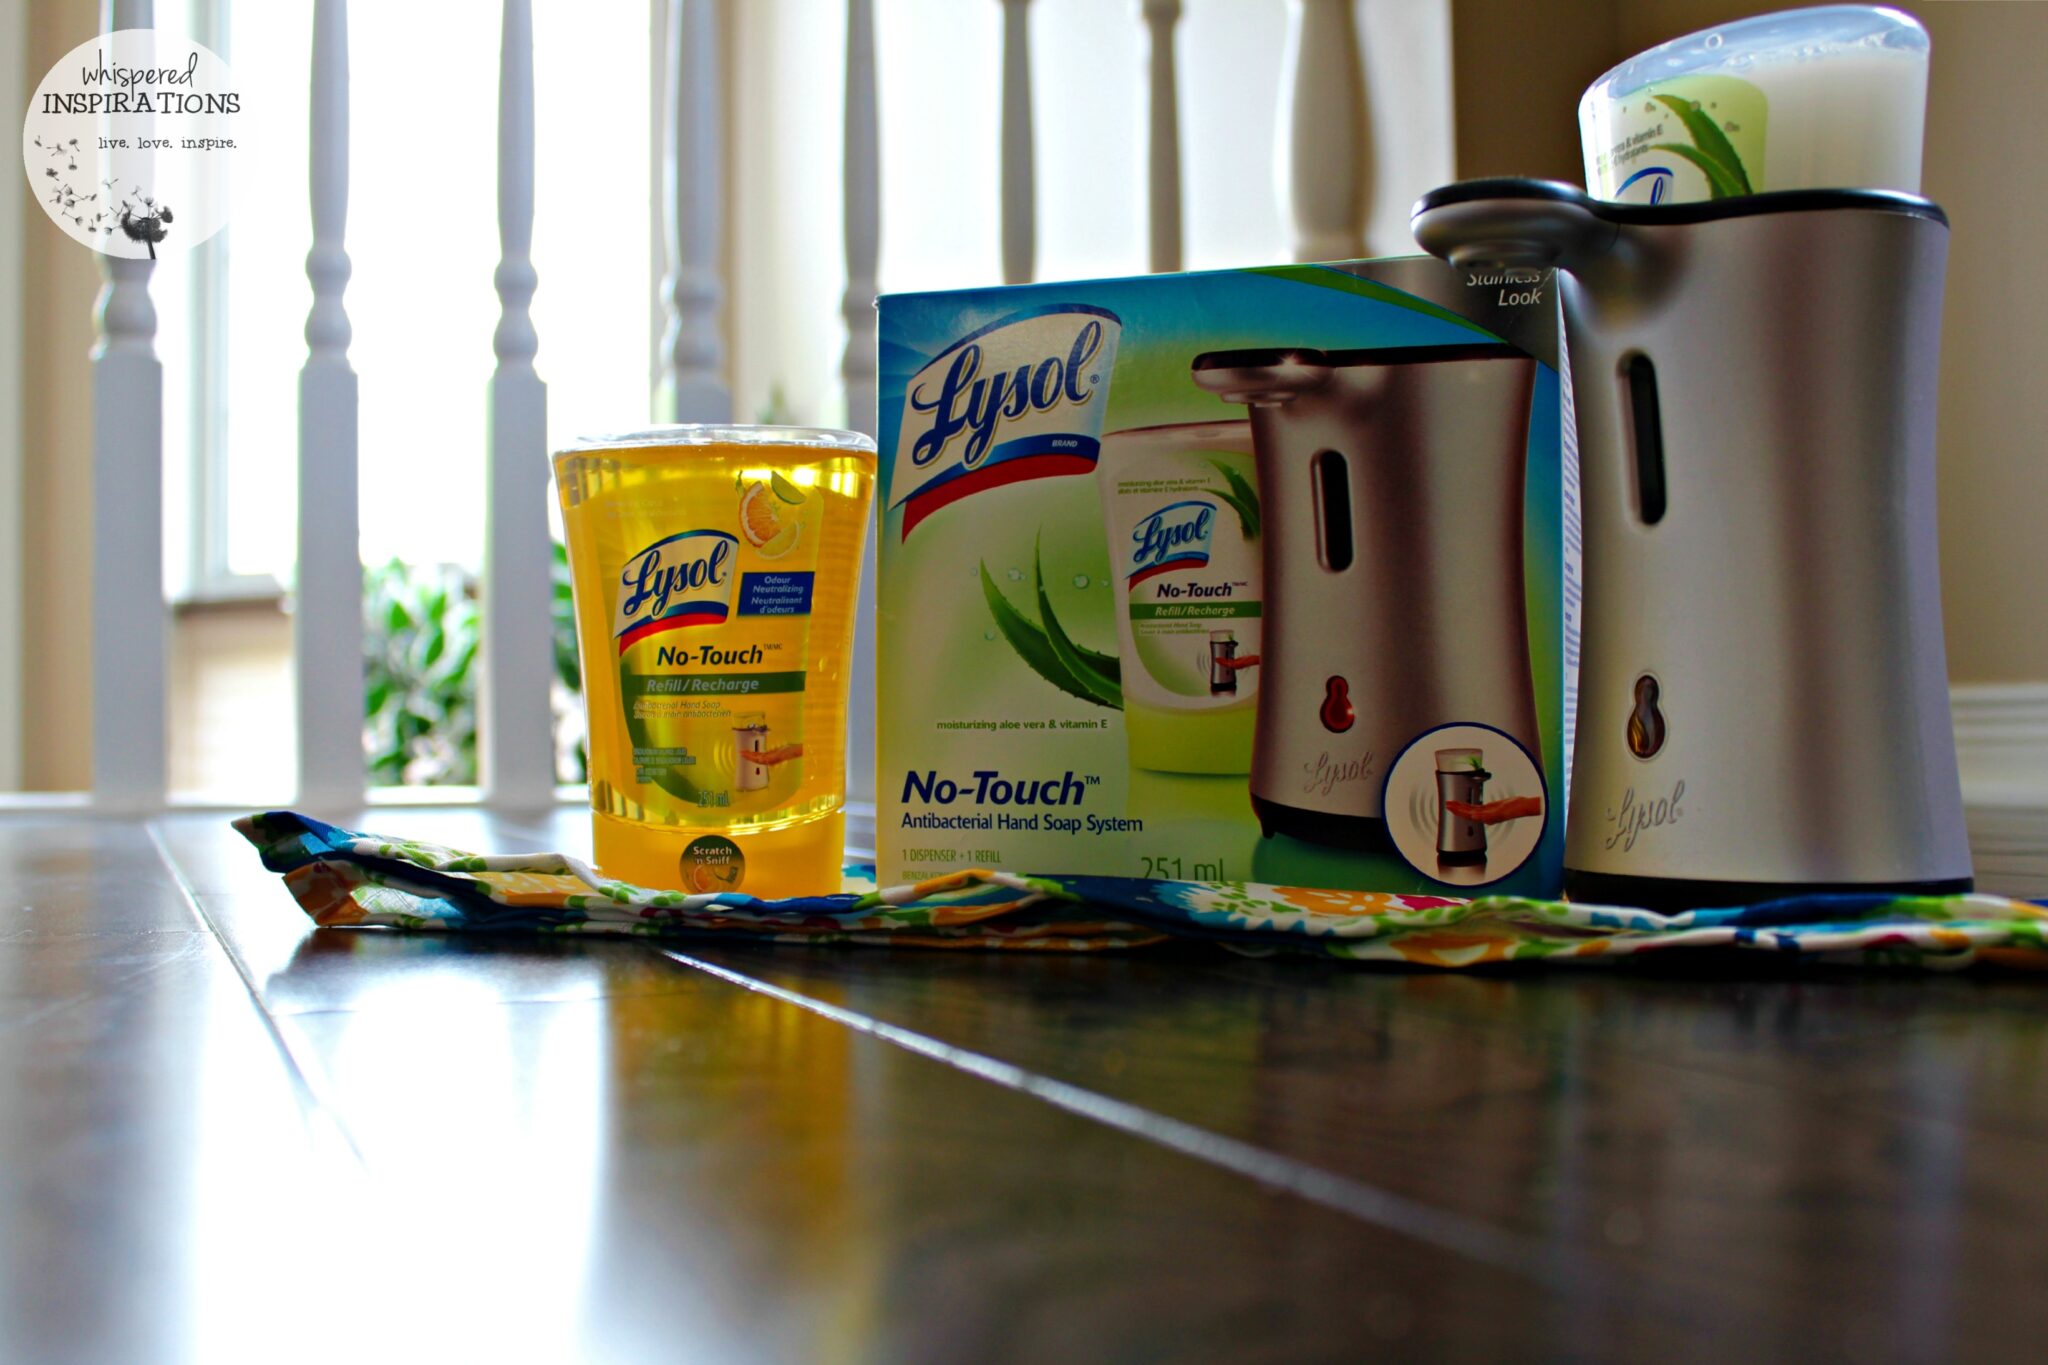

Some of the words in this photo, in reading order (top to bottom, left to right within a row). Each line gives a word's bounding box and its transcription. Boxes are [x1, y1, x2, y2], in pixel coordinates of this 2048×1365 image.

[1498, 287, 1543, 306] Look
[911, 320, 1102, 466] Lysol
[1052, 439, 1078, 448] BRAND
[1132, 507, 1210, 563] Lysol
[622, 539, 729, 617] Lysol
[764, 575, 791, 584] Odour
[753, 584, 804, 594] Neutralizing
[1156, 582, 1232, 598] No-Touch
[751, 596, 803, 605] Neutralisant
[657, 644, 763, 667] No-Touch
[937, 719, 997, 732] moisturizing
[1000, 719, 1021, 730] aloe
[1024, 721, 1046, 730] vera
[1048, 719, 1057, 729] &
[1060, 718, 1098, 729] vitamin
[1101, 719, 1108, 729] E
[1303, 751, 1374, 796] Lysol
[901, 770, 1085, 806] No-Touch
[901, 812, 993, 830] Antibacterial
[998, 813, 1039, 831] Hand
[1043, 813, 1082, 835] Soap
[1086, 814, 1143, 836] System
[1605, 780, 1685, 852] Lysol
[693, 846, 733, 855] Scratch
[902, 848, 907, 862] 1
[910, 848, 957, 863] DISPENSER
[967, 850, 972, 863] 1
[975, 849, 1002, 864] REFILL
[706, 856, 730, 865] Sniff
[1140, 856, 1182, 880] 251
[1194, 857, 1224, 882] ml
